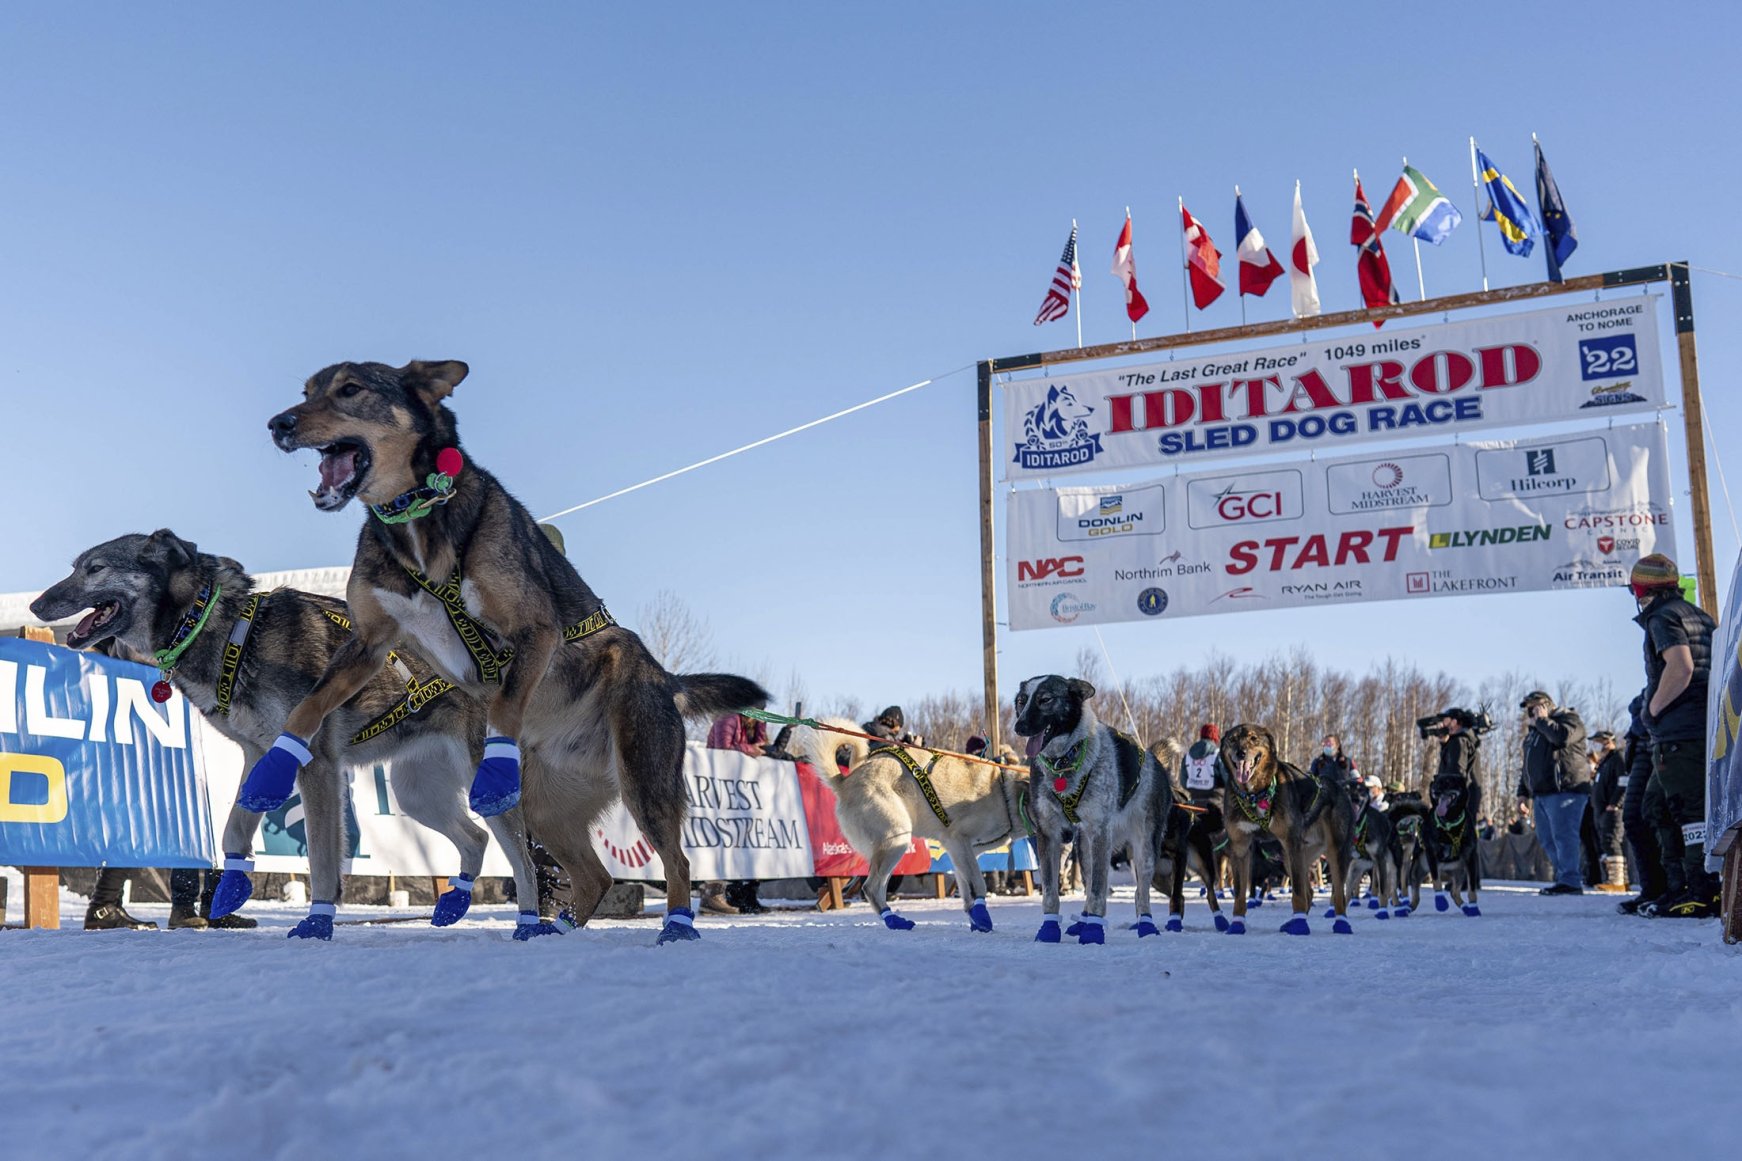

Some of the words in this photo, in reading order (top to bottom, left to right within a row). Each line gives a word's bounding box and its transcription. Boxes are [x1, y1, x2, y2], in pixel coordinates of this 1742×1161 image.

[1566, 304, 1644, 322] ANCHORAGE
[1578, 322, 1594, 331] TO
[1598, 317, 1633, 329] NOME
[1324, 344, 1366, 360] 1049
[1582, 346, 1635, 374] '22
[1118, 373, 1155, 387] "The
[1160, 367, 1197, 382] Last
[1202, 360, 1248, 377] Great
[1254, 352, 1307, 370] Race"
[1103, 342, 1543, 437] IDITAROD
[1159, 422, 1259, 456] SLED
[1269, 411, 1359, 445] DOG
[1367, 395, 1485, 432] RACE
[1026, 448, 1089, 466] IDITAROD
[1510, 476, 1576, 491] Hilcorp
[1362, 486, 1417, 499] HARVEST
[1218, 491, 1282, 521] GCI
[1351, 494, 1429, 509] MIDSTREAM
[1078, 512, 1143, 528] DONLIN
[1564, 513, 1669, 530] CAPSTONE
[1088, 523, 1133, 536] GOLD
[1451, 524, 1552, 547] LYNDEN
[1225, 526, 1414, 576] START
[1018, 555, 1085, 581] NAC
[1115, 567, 1173, 581] Northrim
[1177, 561, 1211, 576] Bank
[1432, 570, 1451, 578] THE
[1553, 572, 1573, 582] Air
[1576, 570, 1623, 580] Transit
[1281, 583, 1328, 594] RYAN
[1333, 580, 1362, 589] AIR
[1433, 575, 1518, 592] LAKEFRONT
[0, 660, 186, 749] LIN
[1196, 768, 1202, 778] 2
[684, 773, 763, 811] ARVEST
